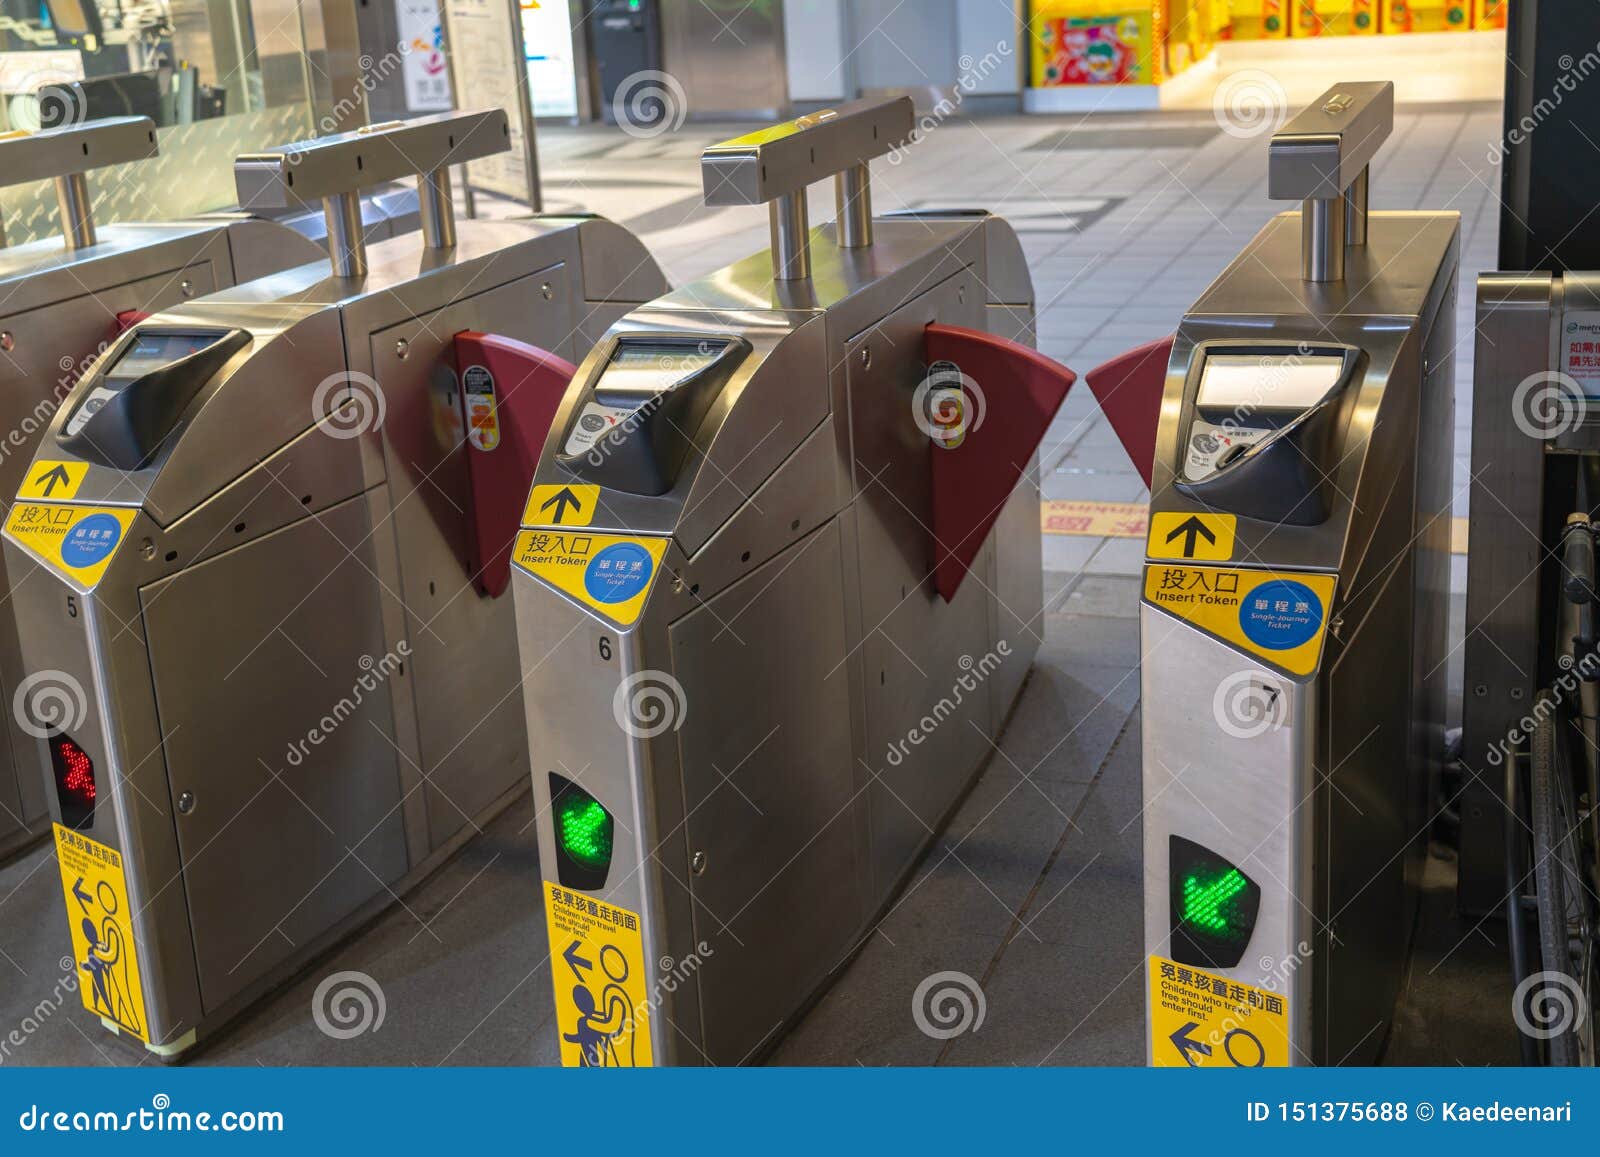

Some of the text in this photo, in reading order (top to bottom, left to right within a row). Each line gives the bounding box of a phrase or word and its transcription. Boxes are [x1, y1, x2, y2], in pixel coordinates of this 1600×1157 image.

[18, 506, 74, 525] 投入口
[12, 524, 67, 536] Insert Token
[527, 534, 592, 555] 投入口
[521, 553, 588, 566] Insert Token
[1160, 568, 1240, 594] 投入口
[67, 596, 77, 618] 5
[1156, 591, 1239, 606] Insert Token
[1254, 599, 1310, 614] 單程票
[1251, 612, 1311, 625] Single-Journey
[1267, 621, 1292, 630] Ticket
[599, 636, 612, 661] 6
[1263, 685, 1281, 712] 7
[1160, 961, 1283, 1016] 免票孩童走前面
[1161, 980, 1252, 1016] Children who travel
[1161, 990, 1213, 1014] free should
[1161, 1000, 1209, 1021] enter first.
